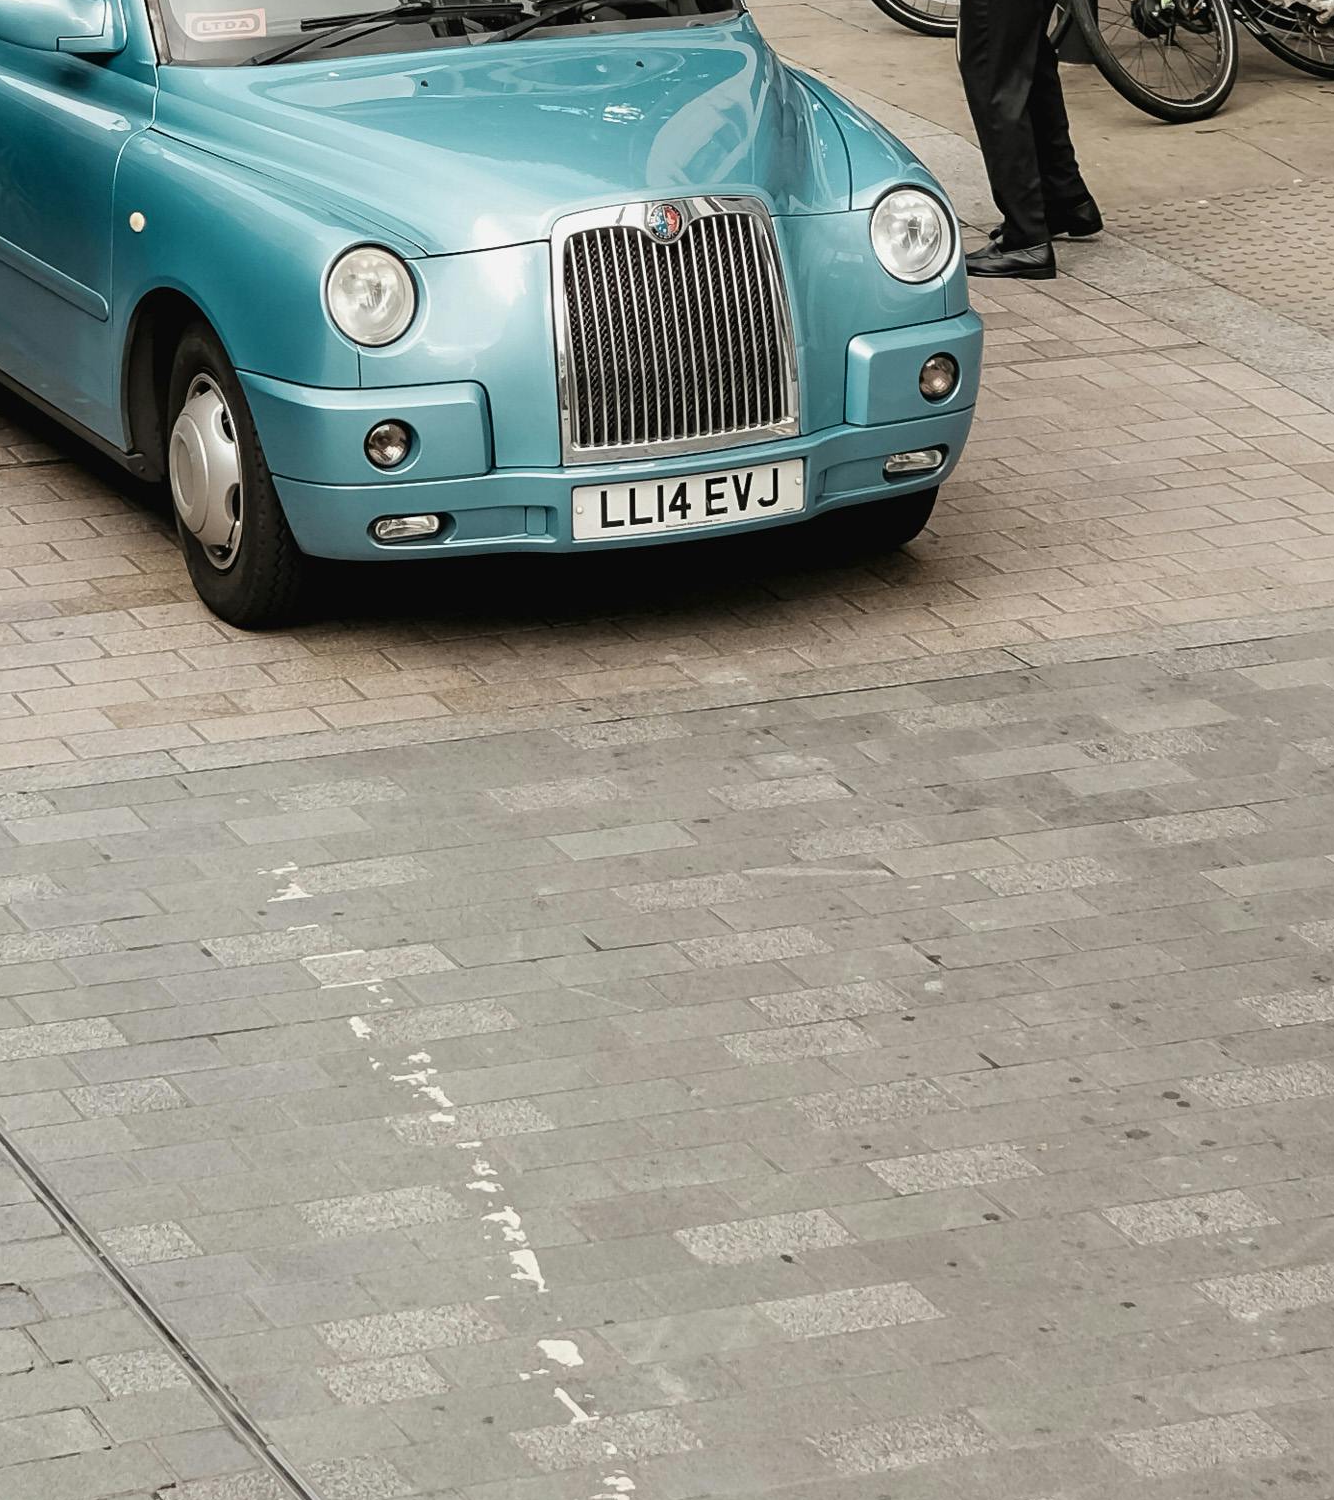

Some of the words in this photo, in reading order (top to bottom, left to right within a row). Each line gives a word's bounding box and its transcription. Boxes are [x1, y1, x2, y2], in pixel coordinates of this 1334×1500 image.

[202, 19, 250, 32] LTDA
[600, 481, 692, 529] LL14
[705, 467, 779, 517] EVJ
